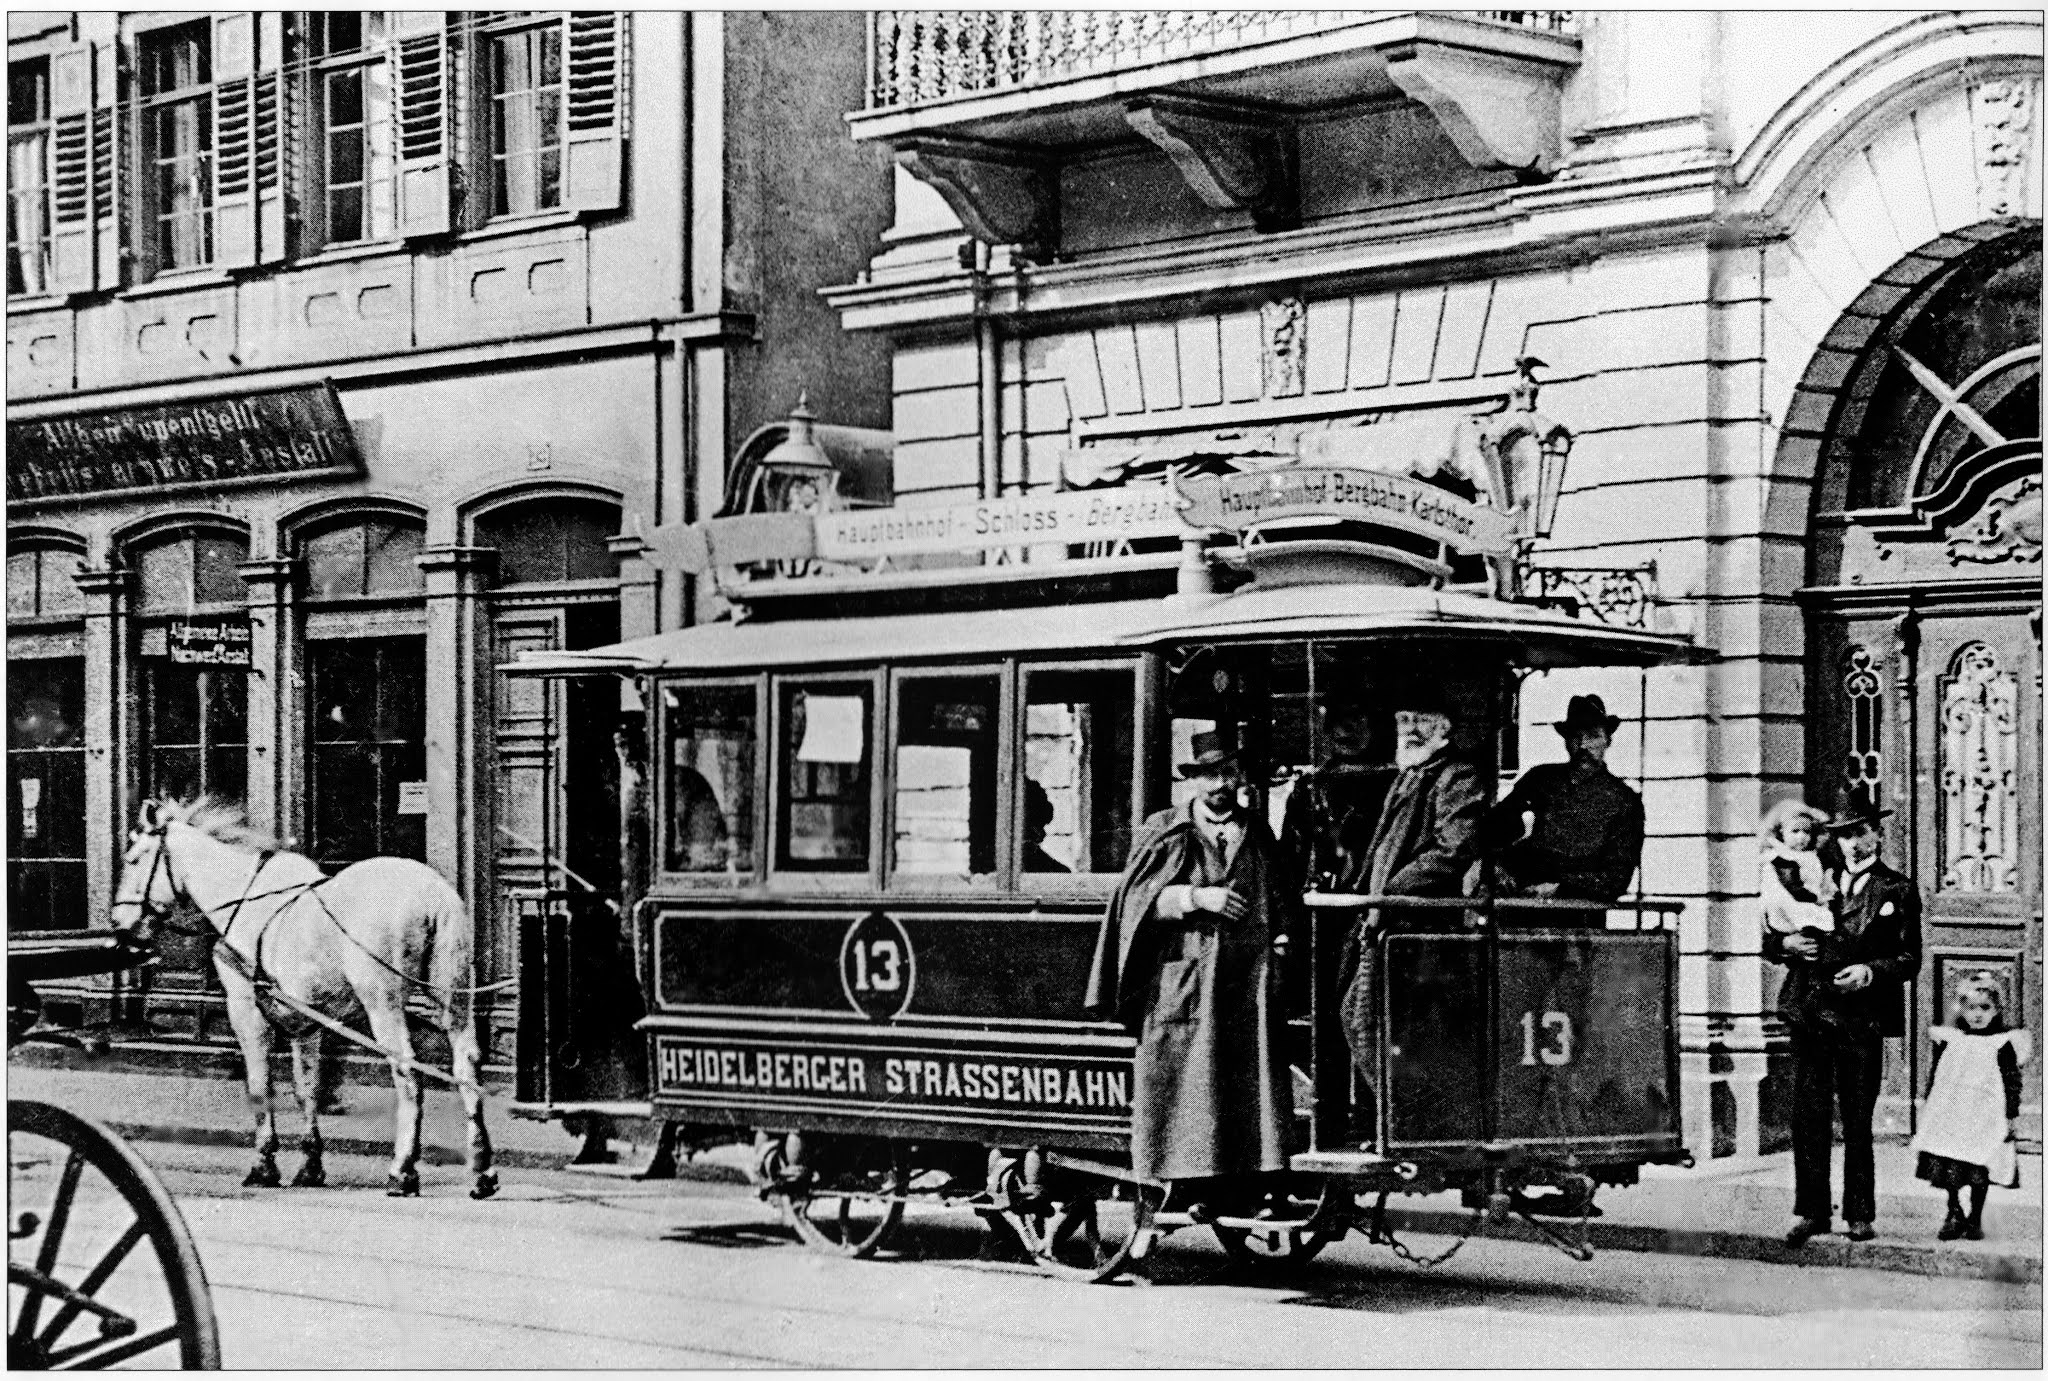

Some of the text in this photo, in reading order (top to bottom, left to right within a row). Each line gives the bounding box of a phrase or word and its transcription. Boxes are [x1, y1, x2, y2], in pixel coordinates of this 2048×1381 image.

[976, 508, 1058, 535] Schloss
[853, 939, 901, 991] 13
[1520, 1011, 1574, 1067] 13
[659, 1047, 1127, 1107] HEIDELBERGER STRASSENBAHN
